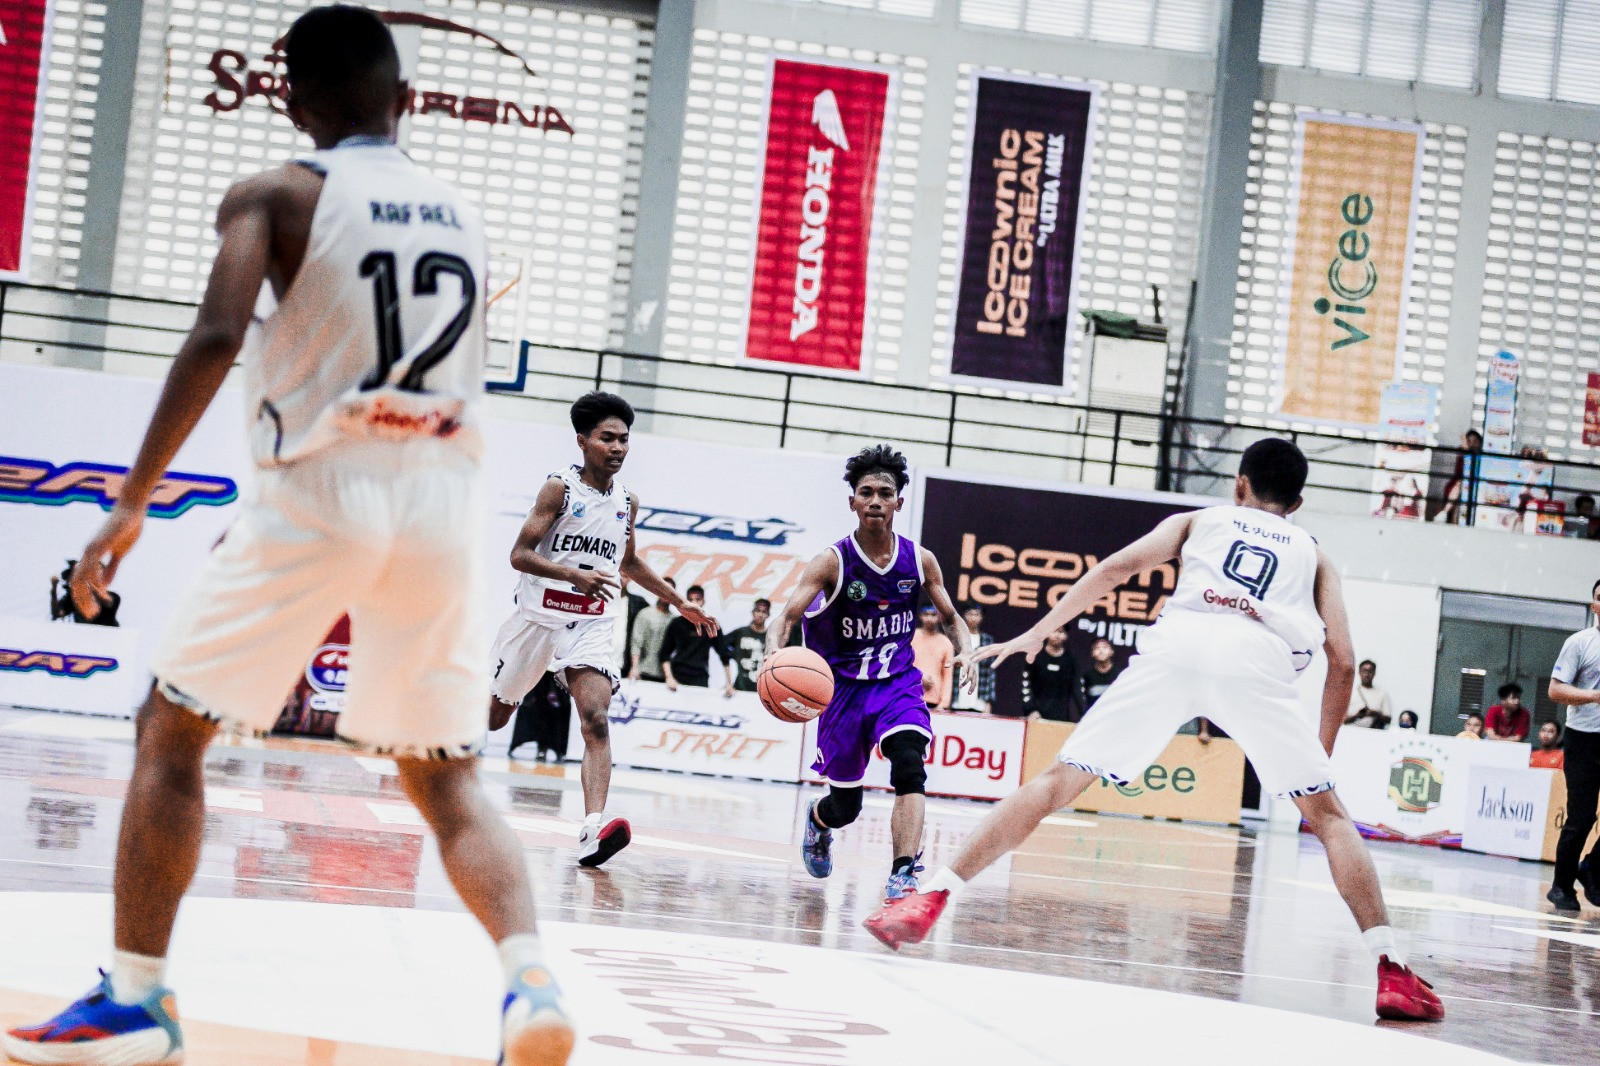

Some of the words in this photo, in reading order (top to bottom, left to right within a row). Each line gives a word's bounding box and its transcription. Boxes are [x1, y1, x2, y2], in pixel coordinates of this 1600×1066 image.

[1045, 133, 1065, 178] MILK
[1013, 130, 1045, 271] CREAM
[1039, 179, 1061, 234] ULTRA
[790, 146, 835, 341] HONDA
[359, 250, 476, 394] 12
[1005, 274, 1032, 337] ICE
[957, 574, 1040, 609] ICE
[1222, 540, 1278, 601] 9
[546, 598, 560, 608] One
[560, 601, 583, 612] HEART
[856, 642, 899, 680] 19
[640, 728, 787, 761] STREET
[941, 735, 1006, 780] Day
[1477, 785, 1534, 822] Jackson
